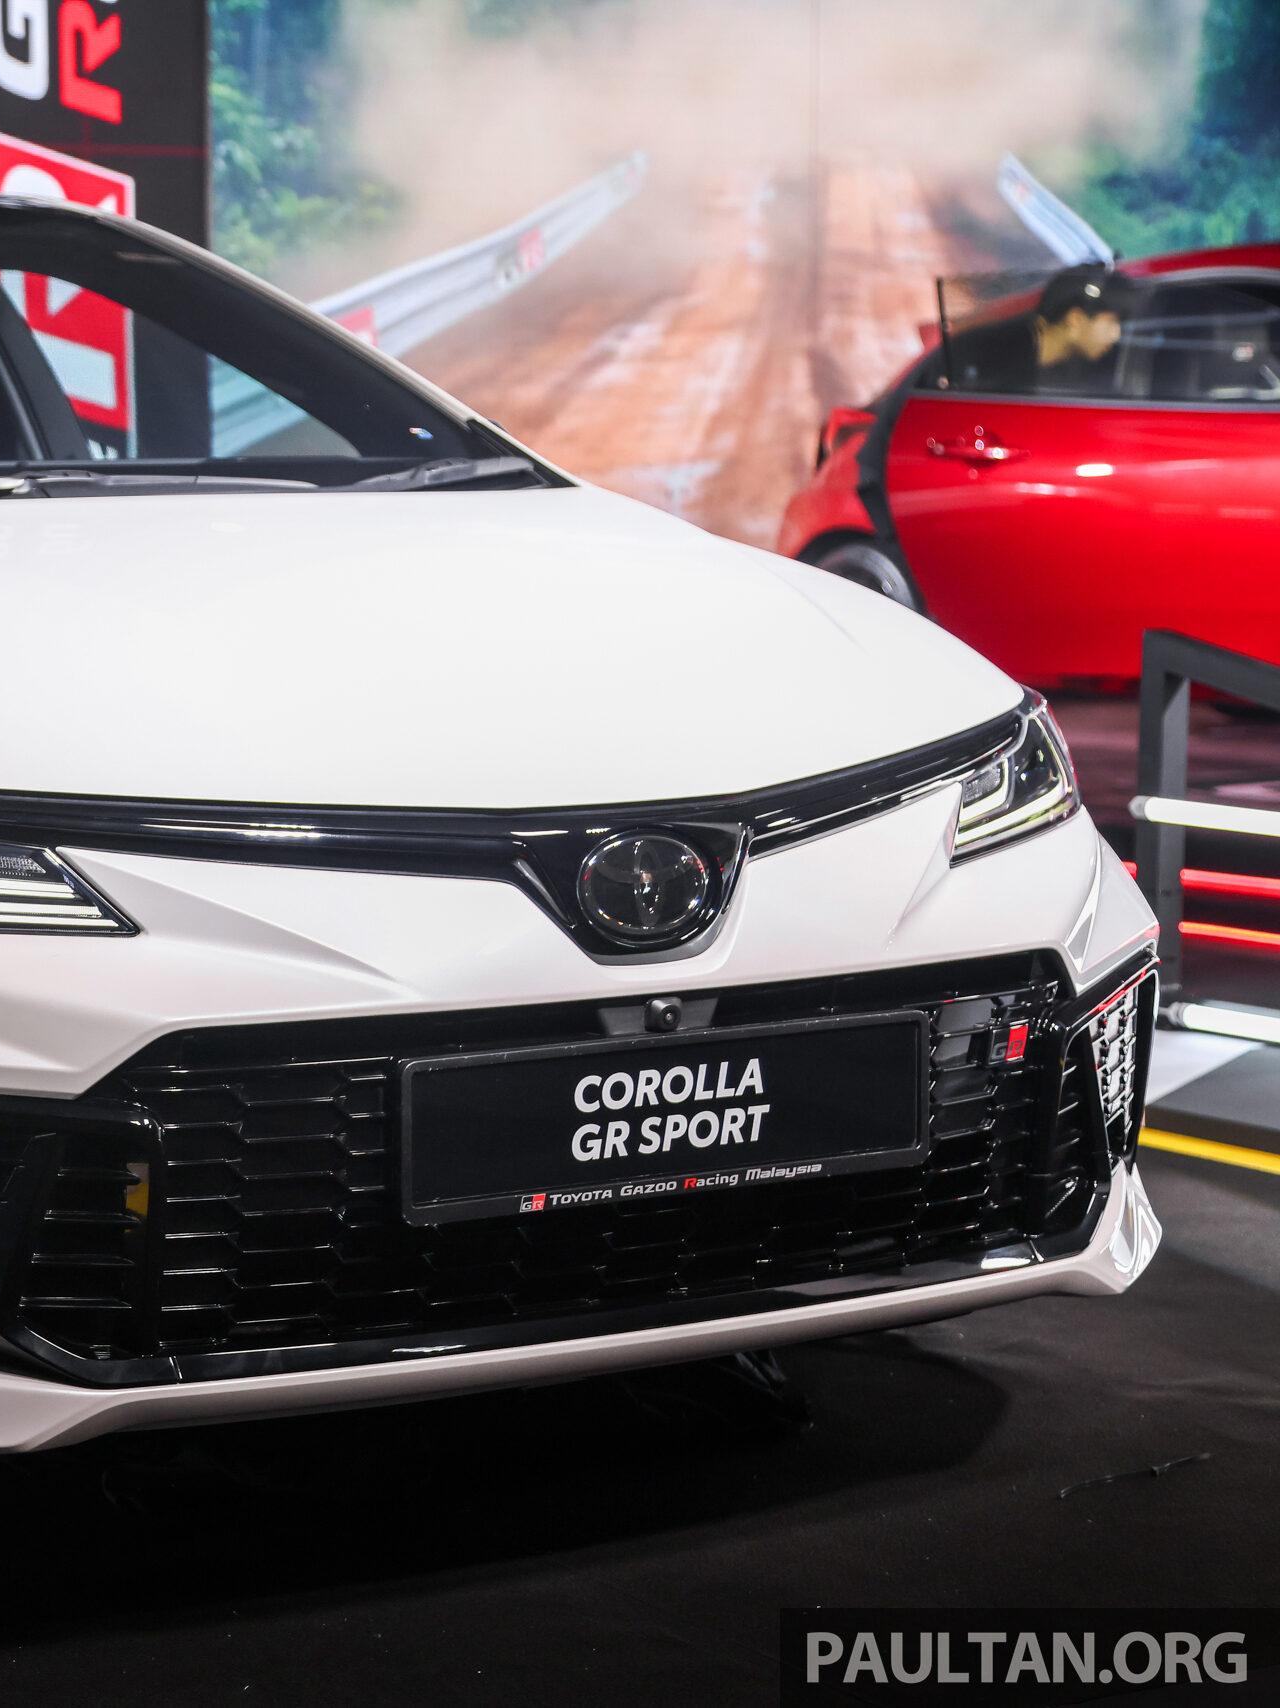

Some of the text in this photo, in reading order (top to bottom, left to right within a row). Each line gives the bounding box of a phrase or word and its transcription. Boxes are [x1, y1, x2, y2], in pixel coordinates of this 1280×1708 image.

[58, 0, 122, 125] R
[574, 1058, 764, 1113] COROLLA
[572, 1104, 770, 1161] GR SPORT
[549, 1189, 612, 1206] TOYOTA
[620, 1179, 677, 1196] GAZOO
[684, 1173, 739, 1190] Racing
[745, 1163, 823, 1181] Malaysia
